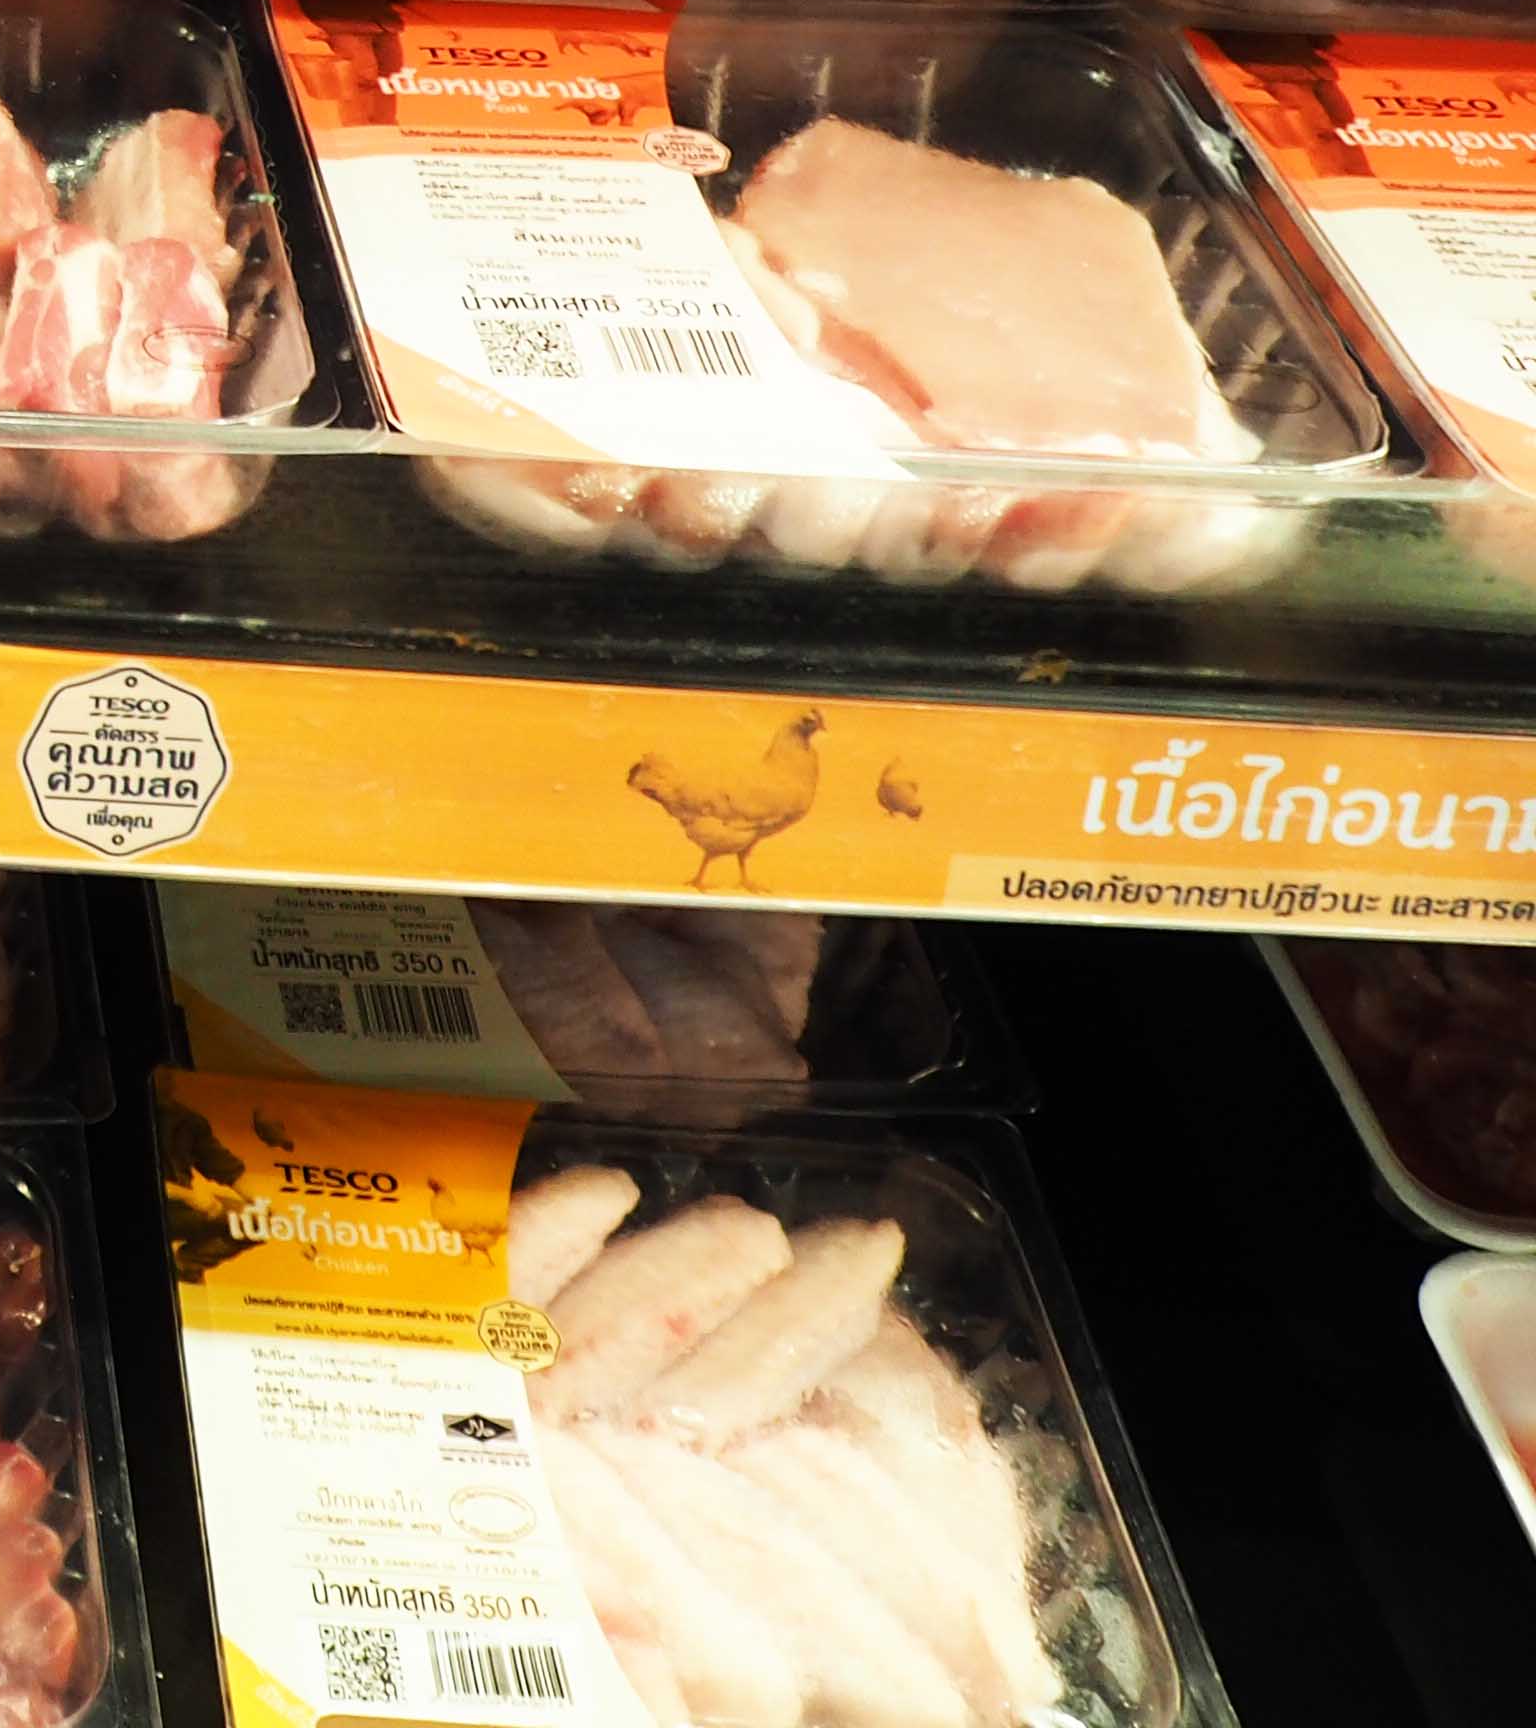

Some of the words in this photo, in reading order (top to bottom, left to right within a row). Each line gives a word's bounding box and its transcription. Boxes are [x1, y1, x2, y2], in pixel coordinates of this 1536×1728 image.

[418, 46, 547, 64] TESCO
[1365, 94, 1502, 116] TESCO
[1454, 155, 1504, 170] Pork
[461, 285, 620, 319] น้ำหนักสุทธิ
[640, 297, 701, 318] 350
[90, 696, 170, 714] TESCO
[95, 724, 159, 744] คัดสรร
[49, 743, 195, 772] คุณภาพ
[47, 771, 199, 800] ความสด
[87, 805, 153, 833] เพื่อคุณ
[1001, 871, 1379, 917] ปลอดภัยจากยาปฏิชีวนะ
[252, 939, 381, 978] น้ำหนักสุทธิ
[391, 952, 444, 974] 350
[274, 1162, 399, 1194] TESCO
[227, 1199, 464, 1258] เนื้อไก่อนามัย
[314, 1255, 389, 1275] Chicken
[311, 1569, 455, 1622] น้ำหนักสุทธิ
[465, 1592, 513, 1620] 350
